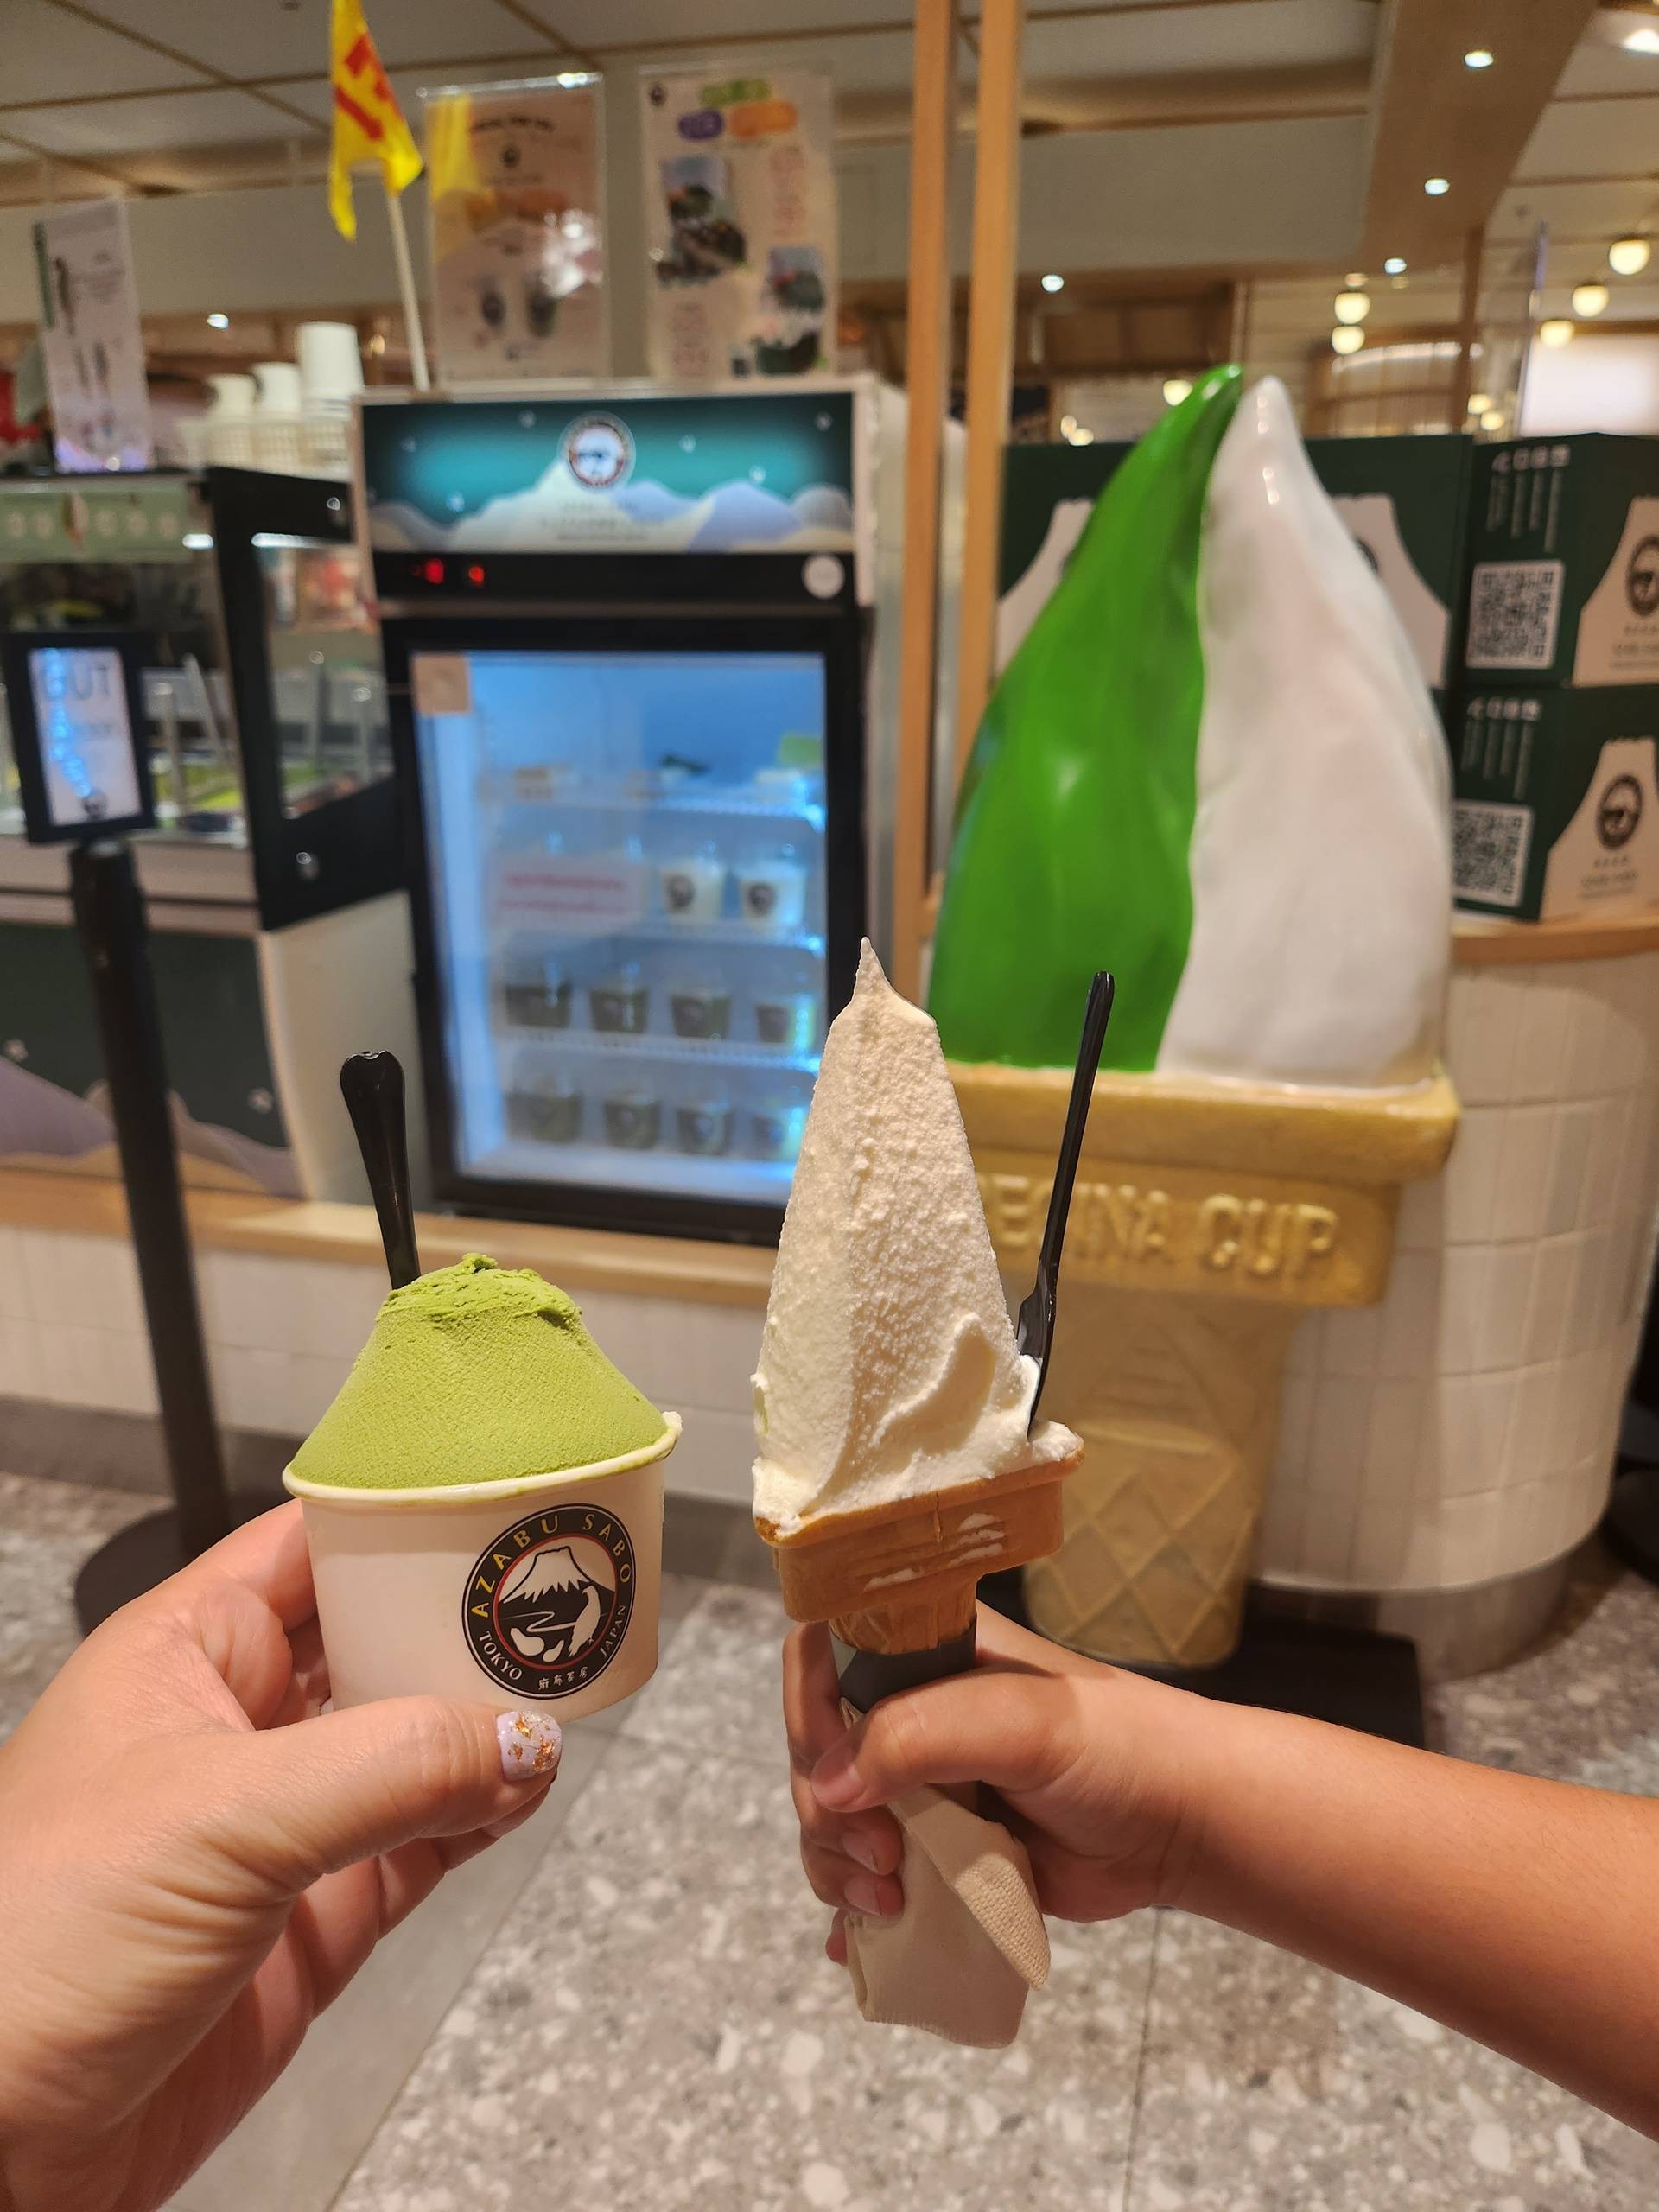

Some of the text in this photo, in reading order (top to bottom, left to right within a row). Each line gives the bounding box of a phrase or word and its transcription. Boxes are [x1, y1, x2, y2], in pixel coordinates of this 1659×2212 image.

[1200, 1192, 1339, 1275] CUP
[471, 1514, 632, 1618] AZABU SABO
[479, 1630, 523, 1681] TOKYO
[600, 1605, 626, 1657] JAPAN
